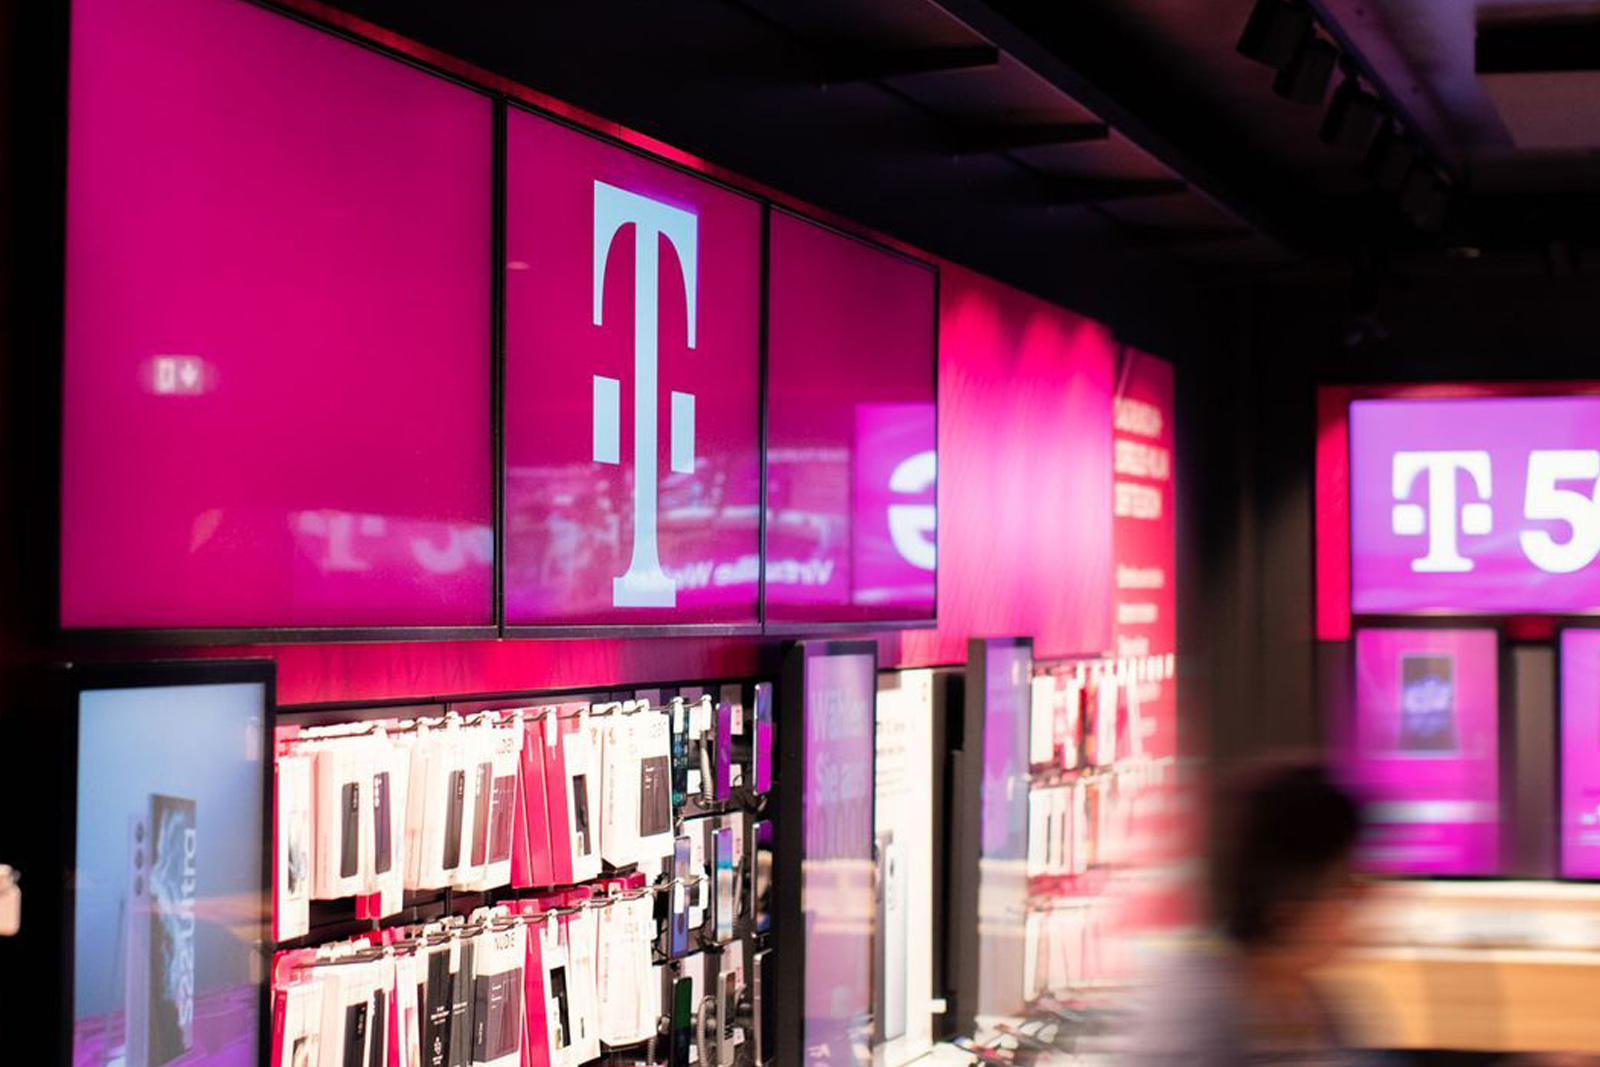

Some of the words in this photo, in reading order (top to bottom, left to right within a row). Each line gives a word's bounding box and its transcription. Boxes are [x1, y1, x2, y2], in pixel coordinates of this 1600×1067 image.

[593, 180, 698, 608] T
[1392, 450, 1493, 573] T
[1519, 449, 1600, 574] 5
